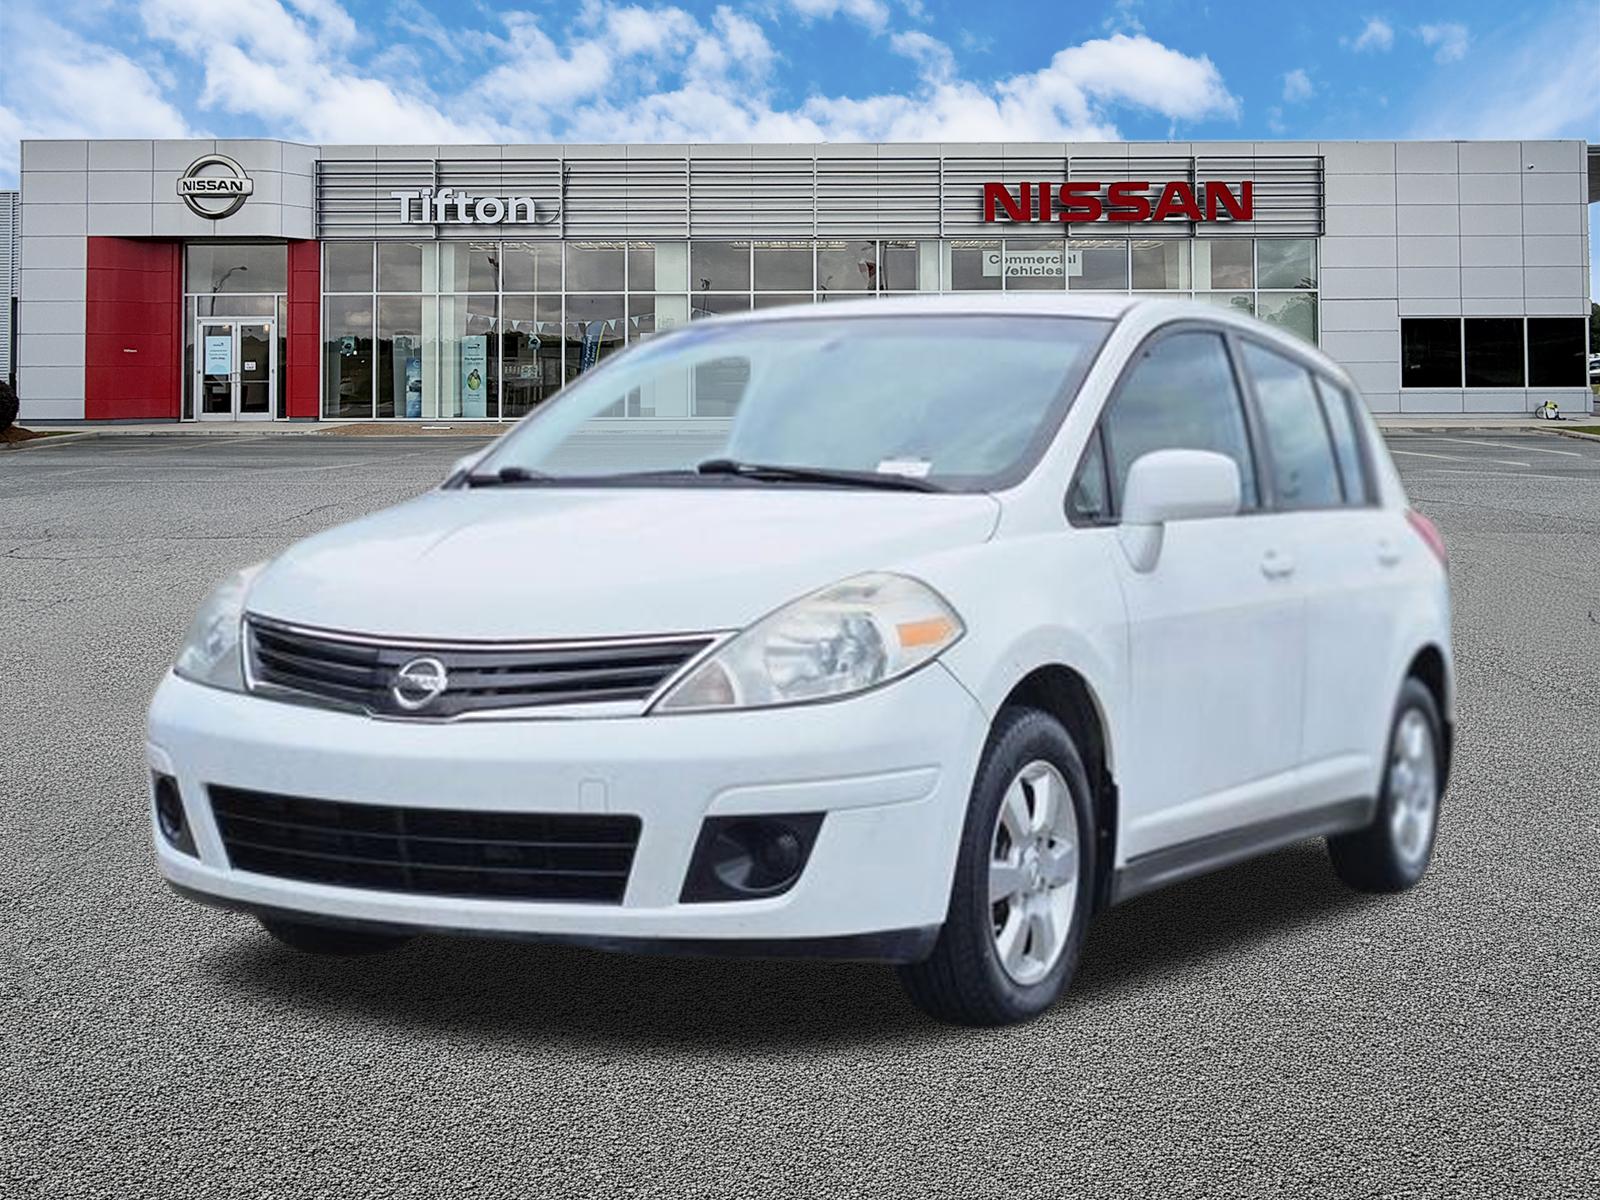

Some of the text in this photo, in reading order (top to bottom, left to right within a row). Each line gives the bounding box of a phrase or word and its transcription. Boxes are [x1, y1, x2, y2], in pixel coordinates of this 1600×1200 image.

[183, 180, 243, 191] NISSAN
[983, 181, 1254, 222] NISSAN
[391, 187, 536, 224] Tifton
